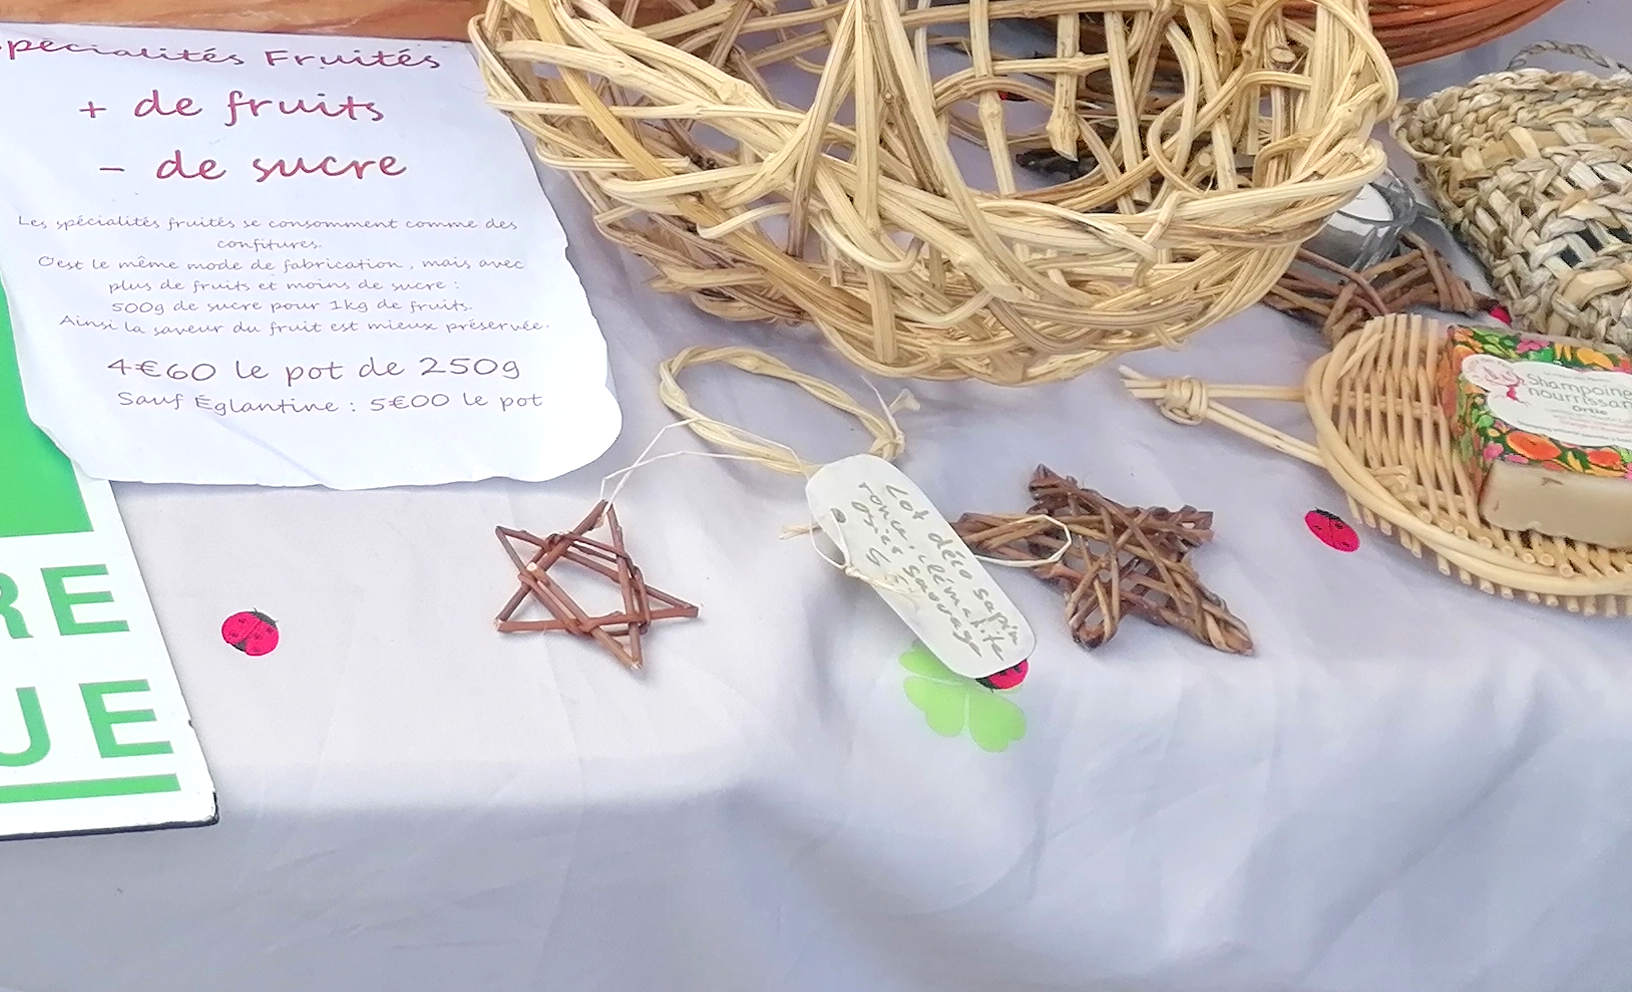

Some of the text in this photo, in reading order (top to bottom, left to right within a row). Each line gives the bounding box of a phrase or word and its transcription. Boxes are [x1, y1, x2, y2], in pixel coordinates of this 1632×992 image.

[265, 49, 442, 70] Fruités
[134, 89, 204, 119] de
[225, 89, 384, 127] fruits
[156, 149, 407, 183] de sucre
[18, 215, 518, 231] Les spécialités fruités se consomment comme des
[217, 238, 322, 253] confitures.
[92, 257, 110, 270] le
[118, 255, 179, 270] même
[187, 258, 243, 270] mode
[251, 258, 276, 270] de
[422, 257, 471, 270] mais
[478, 258, 525, 270] avec
[108, 278, 446, 294] plus de fruits et moins de sucre
[112, 302, 164, 316] 500g
[173, 300, 199, 312] de
[207, 302, 262, 312] sucre
[270, 300, 320, 314] pour
[330, 299, 368, 314] 1kg
[376, 299, 402, 310] de
[58, 314, 118, 331] Ainsi
[125, 321, 146, 334] la
[154, 324, 225, 337] saveur
[233, 321, 259, 334] du
[270, 320, 322, 337] fruit
[330, 322, 359, 333] est
[367, 320, 438, 332] mieux
[107, 356, 520, 387] 4€60 le pot de 250g
[117, 391, 543, 416] Sauf Églantine 5€00 le pot
[886, 483, 1020, 646] Lot déco sapin
